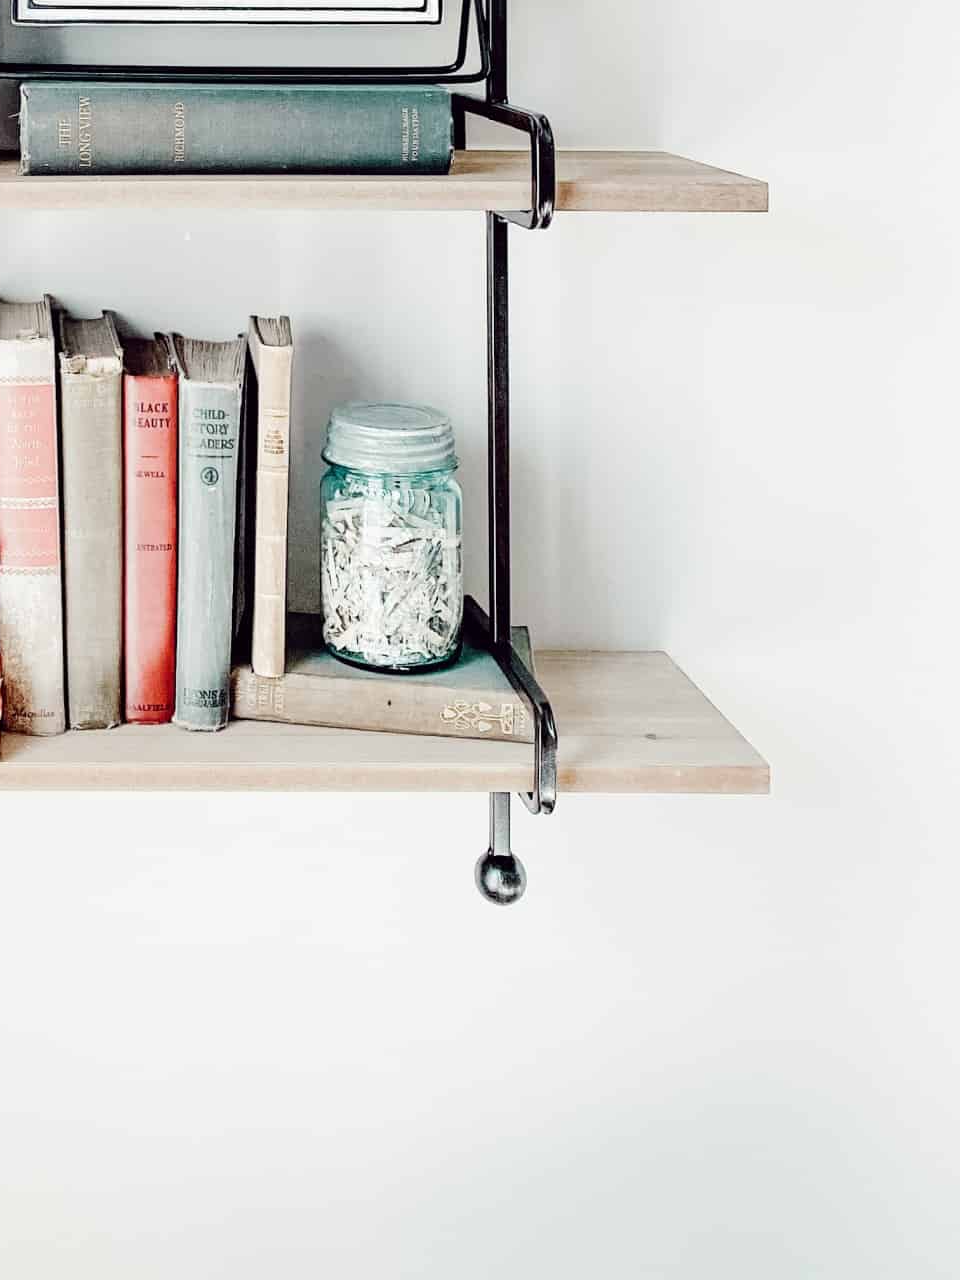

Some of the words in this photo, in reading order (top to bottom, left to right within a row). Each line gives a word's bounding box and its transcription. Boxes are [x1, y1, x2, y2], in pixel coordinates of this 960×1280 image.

[78, 95, 92, 130] VIEW
[58, 119, 72, 144] THE
[174, 102, 185, 162] RICHMOND
[78, 133, 92, 168] LONG
[136, 419, 170, 429] EAUTY
[192, 438, 235, 450] ADERS
[136, 471, 165, 479] EWELL
